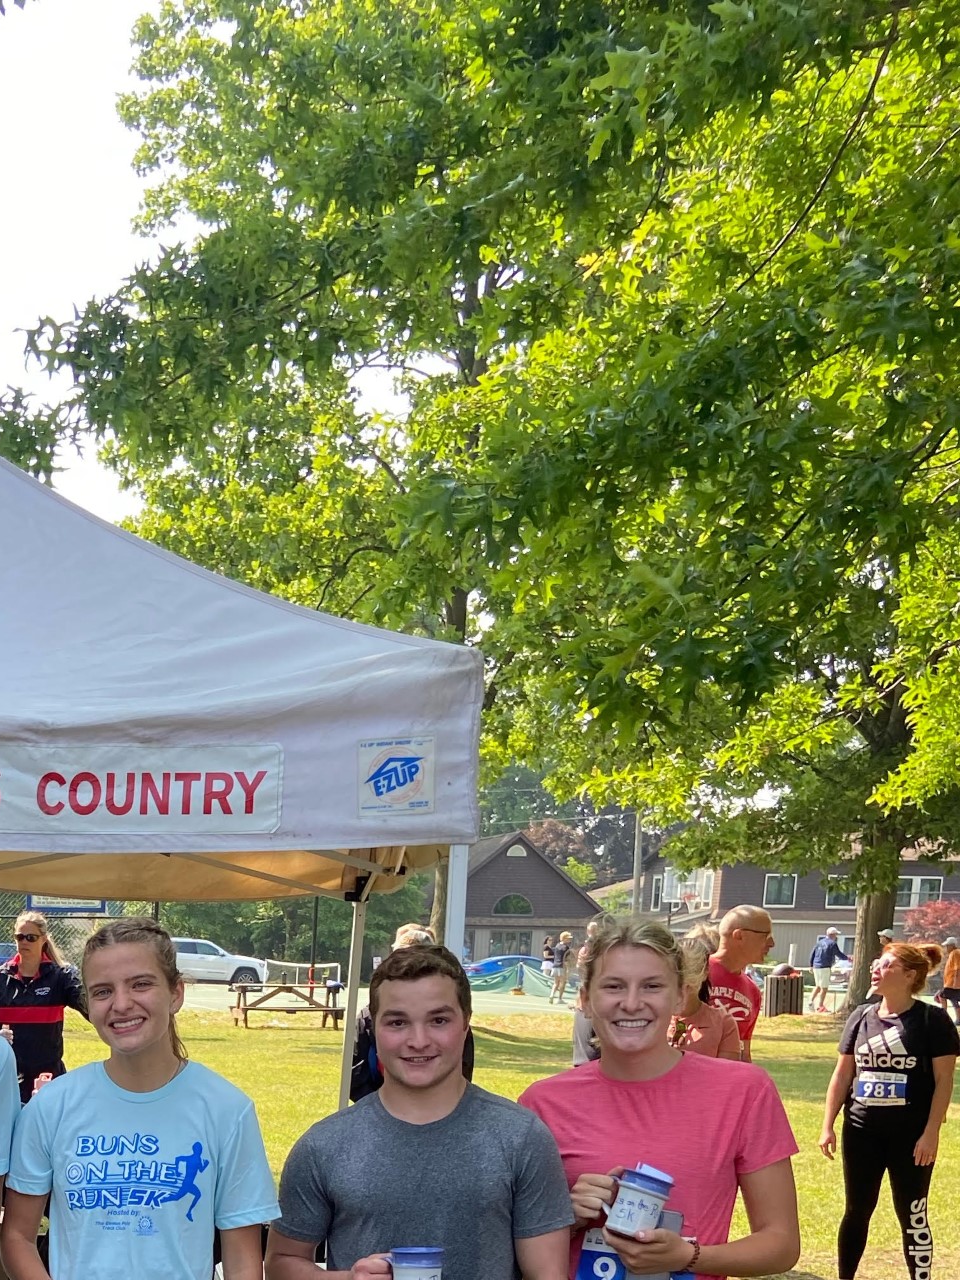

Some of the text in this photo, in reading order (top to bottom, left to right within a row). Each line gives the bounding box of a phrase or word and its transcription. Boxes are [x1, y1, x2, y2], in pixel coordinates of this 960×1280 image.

[36, 770, 268, 816] COUNTRY
[855, 1053, 917, 1069] adidas
[863, 1082, 897, 1098] 981
[76, 1133, 159, 1156] BUNS
[65, 1160, 178, 1184] ON THE
[65, 1187, 170, 1210] RUN 5K
